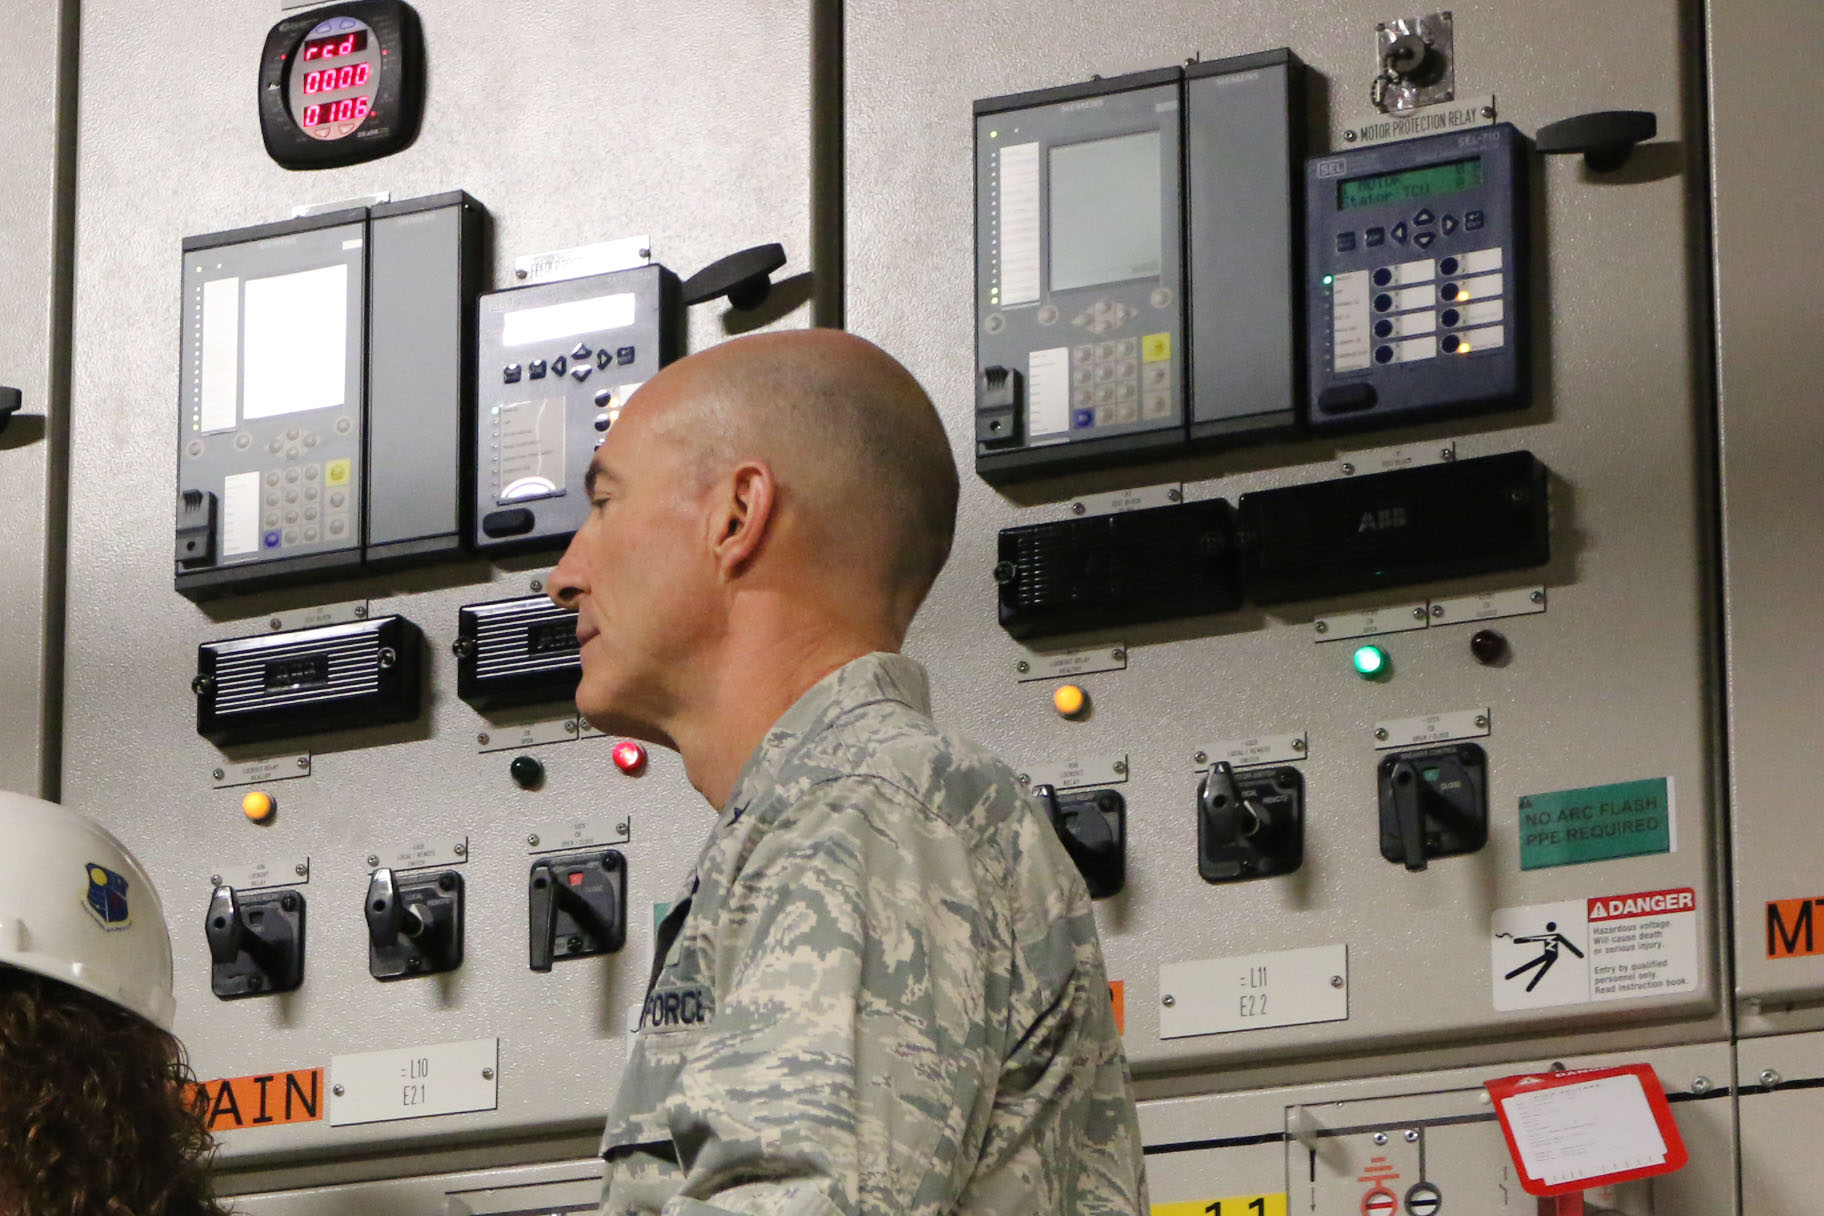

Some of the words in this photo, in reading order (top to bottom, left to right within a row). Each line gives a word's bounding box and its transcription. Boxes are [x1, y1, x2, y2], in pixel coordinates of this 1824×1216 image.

[306, 62, 370, 94] 0000
[1360, 124, 1390, 142] MOTOR
[1392, 115, 1447, 138] PROTECTION
[1448, 109, 1477, 127] RELAY
[1319, 162, 1343, 176] SEL
[1358, 507, 1407, 533] ABB
[1526, 811, 1551, 827] NO
[1557, 805, 1593, 823] ARC
[1599, 797, 1658, 816] FLASH
[1526, 830, 1561, 846] PPE
[1566, 816, 1659, 844] REQUIRED
[1608, 892, 1693, 916] DANGER
[1593, 924, 1637, 935] Hazardous
[1593, 936, 1609, 945] Will
[1611, 934, 1636, 943] cause
[1639, 931, 1663, 940] death
[1605, 944, 1635, 954] serious
[1594, 965, 1615, 975] Entry
[1618, 964, 1628, 973] by
[1631, 960, 1668, 971] qualified
[1594, 974, 1636, 985] personnel
[1594, 985, 1616, 994] Read
[1618, 981, 1663, 992] instruction
[1555, 1066, 1618, 1078] DAN
[198, 1071, 318, 1128] AIN
